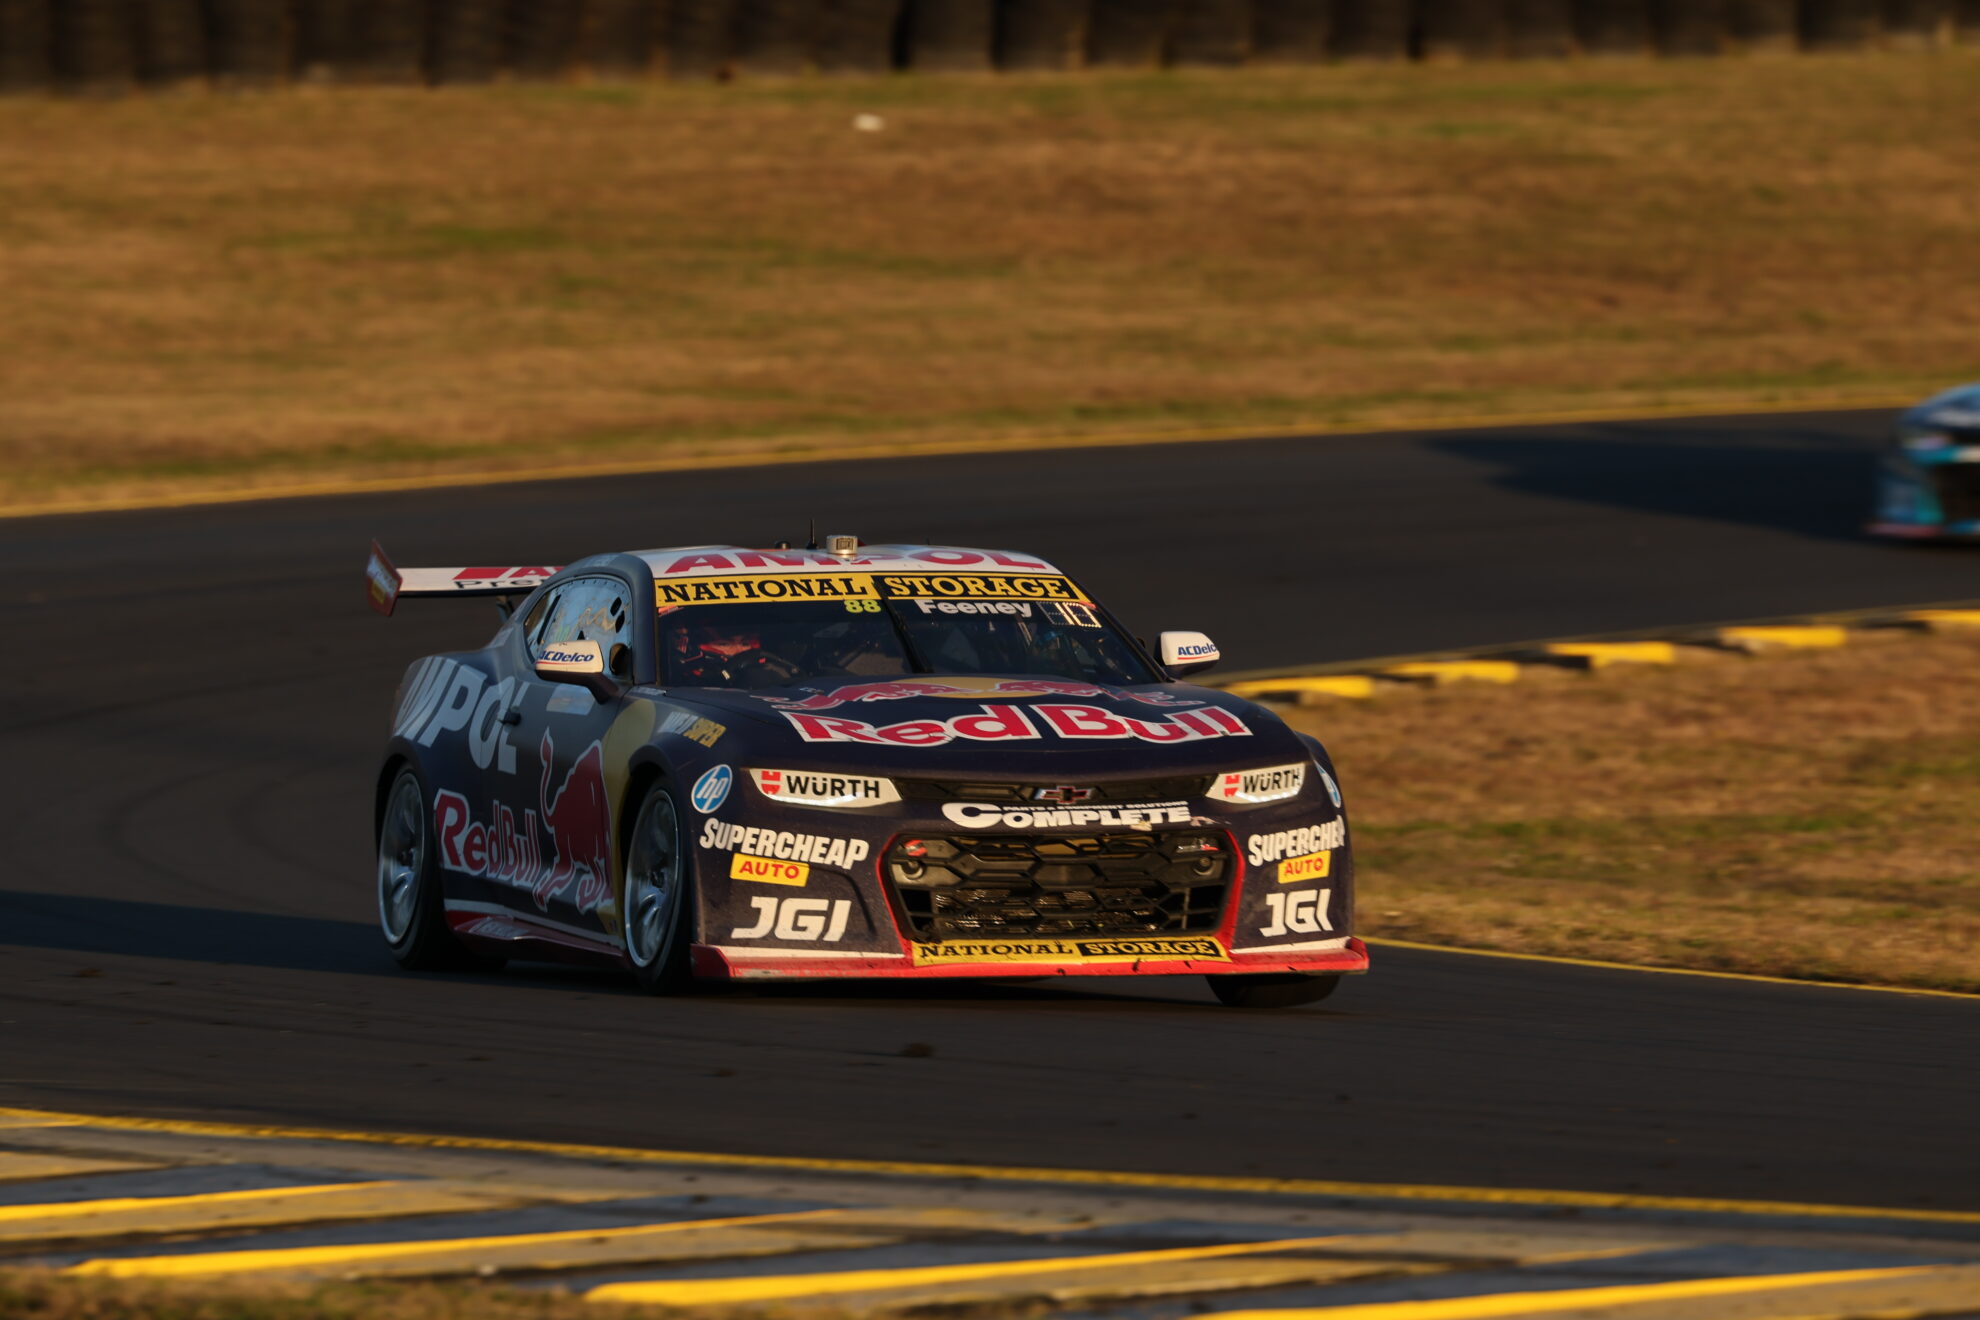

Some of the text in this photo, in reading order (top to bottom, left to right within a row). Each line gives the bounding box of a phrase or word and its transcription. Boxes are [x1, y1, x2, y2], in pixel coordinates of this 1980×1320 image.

[665, 551, 1046, 574] AMPOL
[659, 576, 1070, 602] NATIONAL STORAGE
[843, 599, 882, 613] 88
[914, 599, 1032, 618] Feeney
[778, 704, 1254, 747] Red Bull
[695, 766, 730, 812] hp
[942, 802, 1192, 829] COMPLETE
[434, 788, 541, 888] Red Bull
[699, 817, 870, 870] SUPERCHEAP
[739, 861, 800, 880] AUTO
[1284, 857, 1323, 877] AUTO
[730, 896, 852, 942] JGI
[1258, 888, 1334, 937] JGI
[920, 941, 1218, 958] NATIONAL STORAGE
